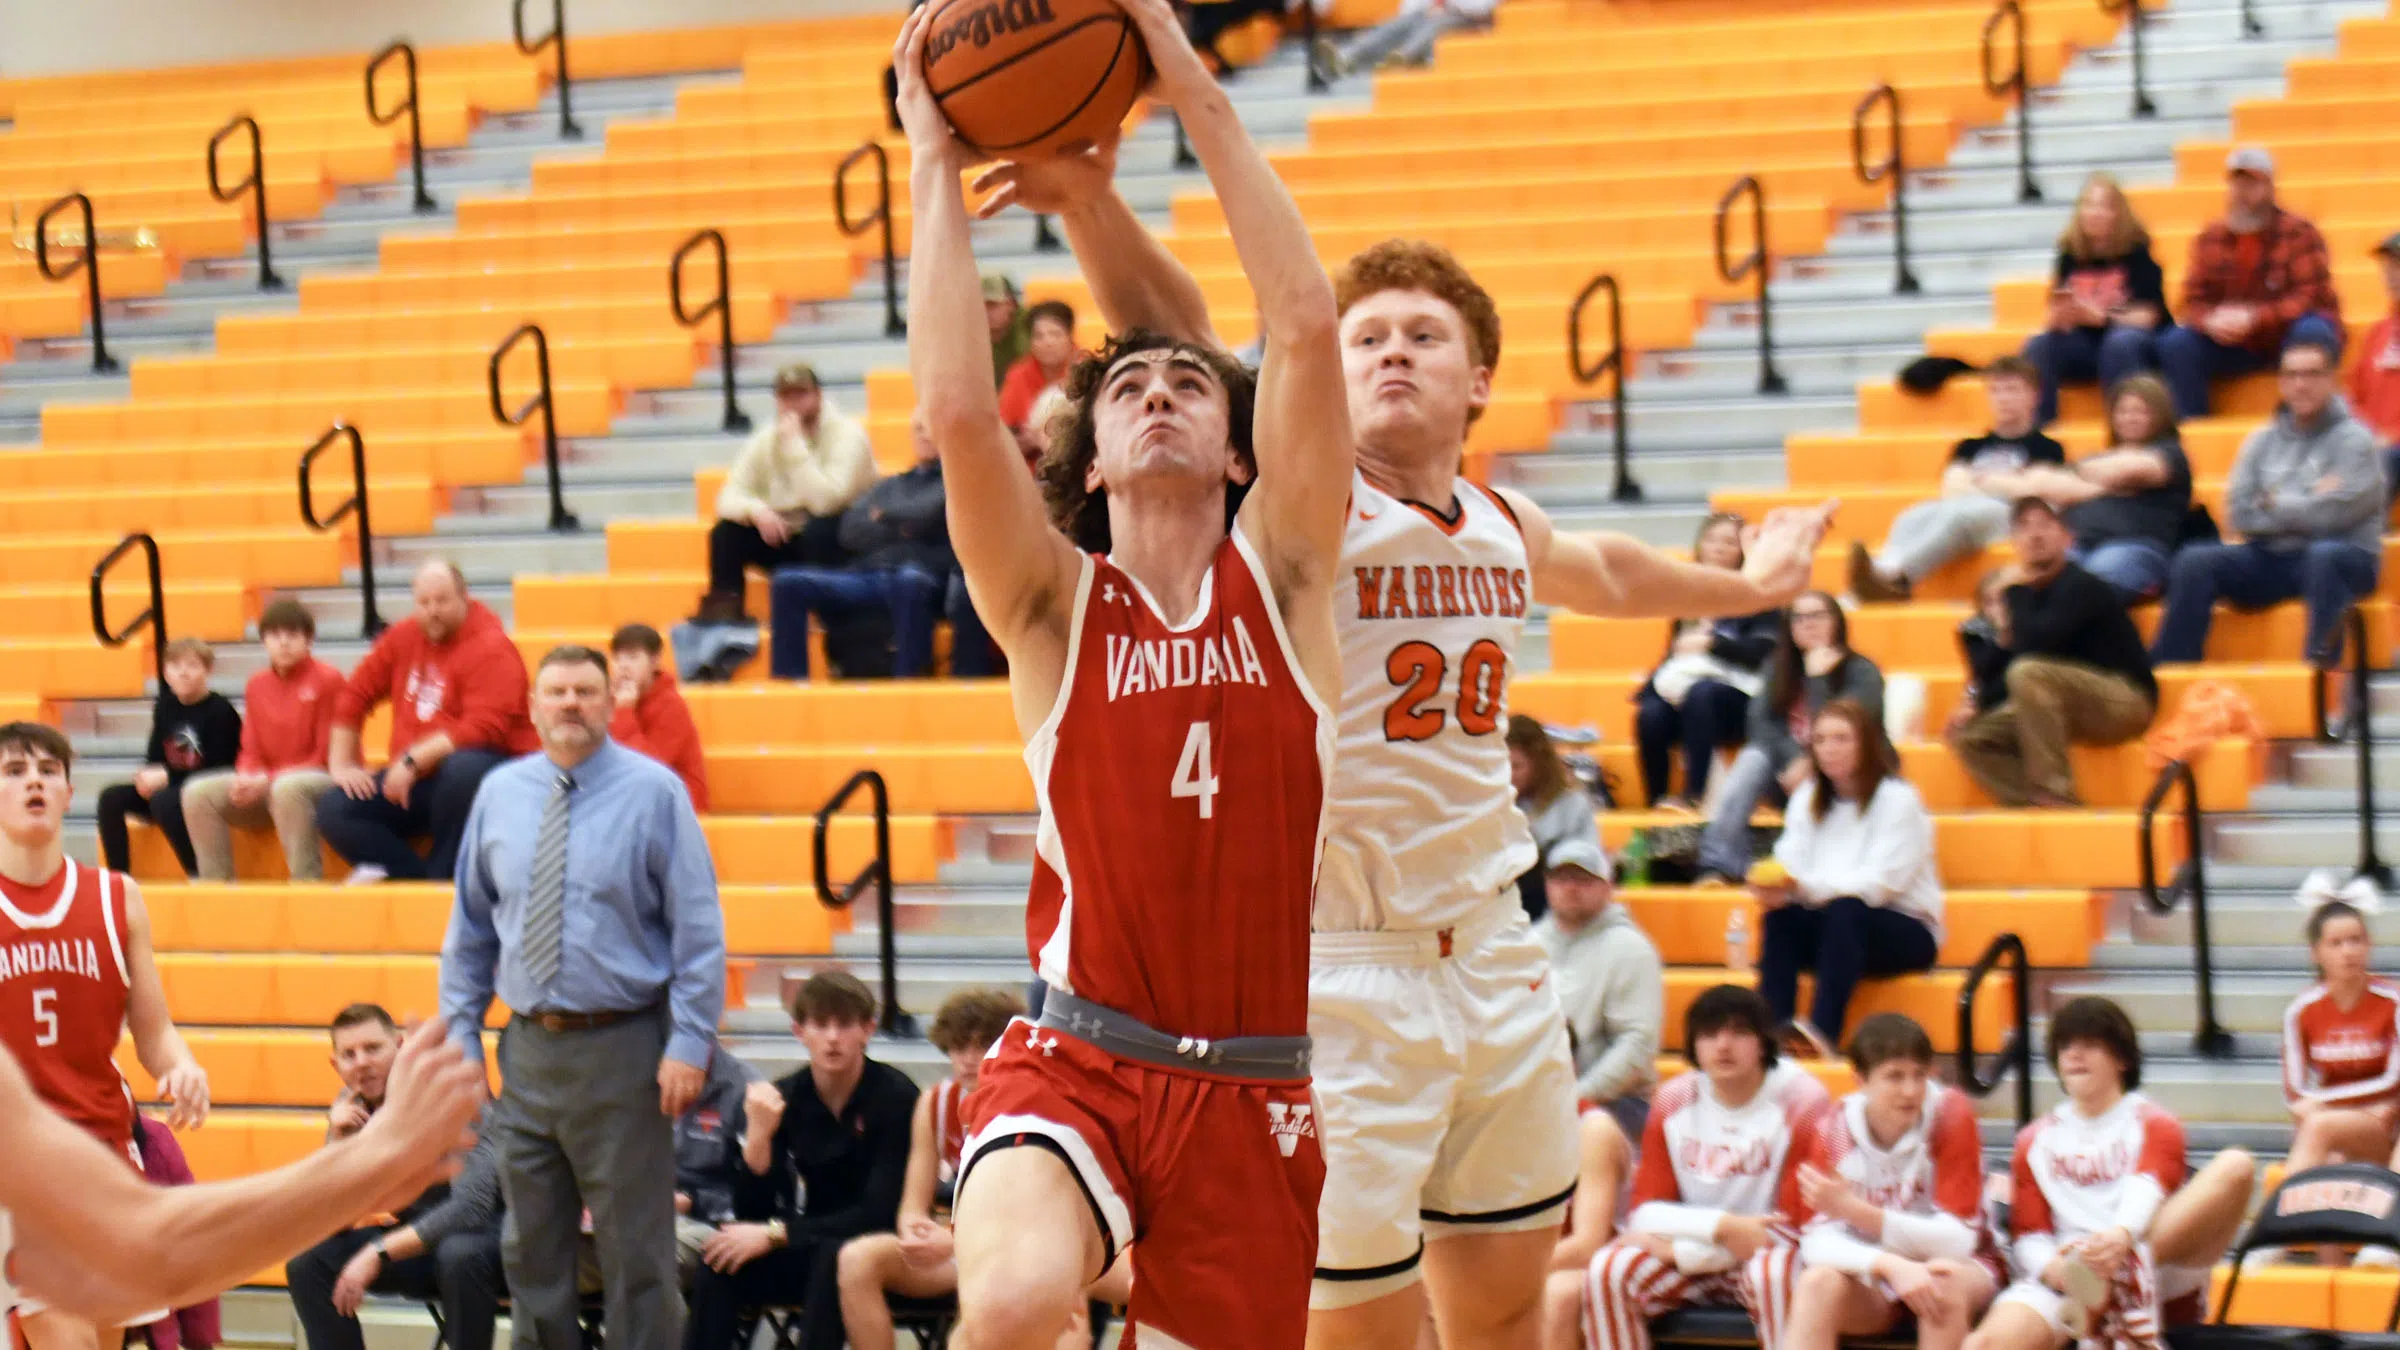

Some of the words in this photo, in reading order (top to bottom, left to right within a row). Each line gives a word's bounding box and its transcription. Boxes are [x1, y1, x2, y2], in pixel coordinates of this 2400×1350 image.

[1354, 566, 1527, 619] WARRIORS
[1383, 638, 1506, 742] 20
[1171, 720, 1219, 819] 4
[32, 987, 58, 1047] 5
